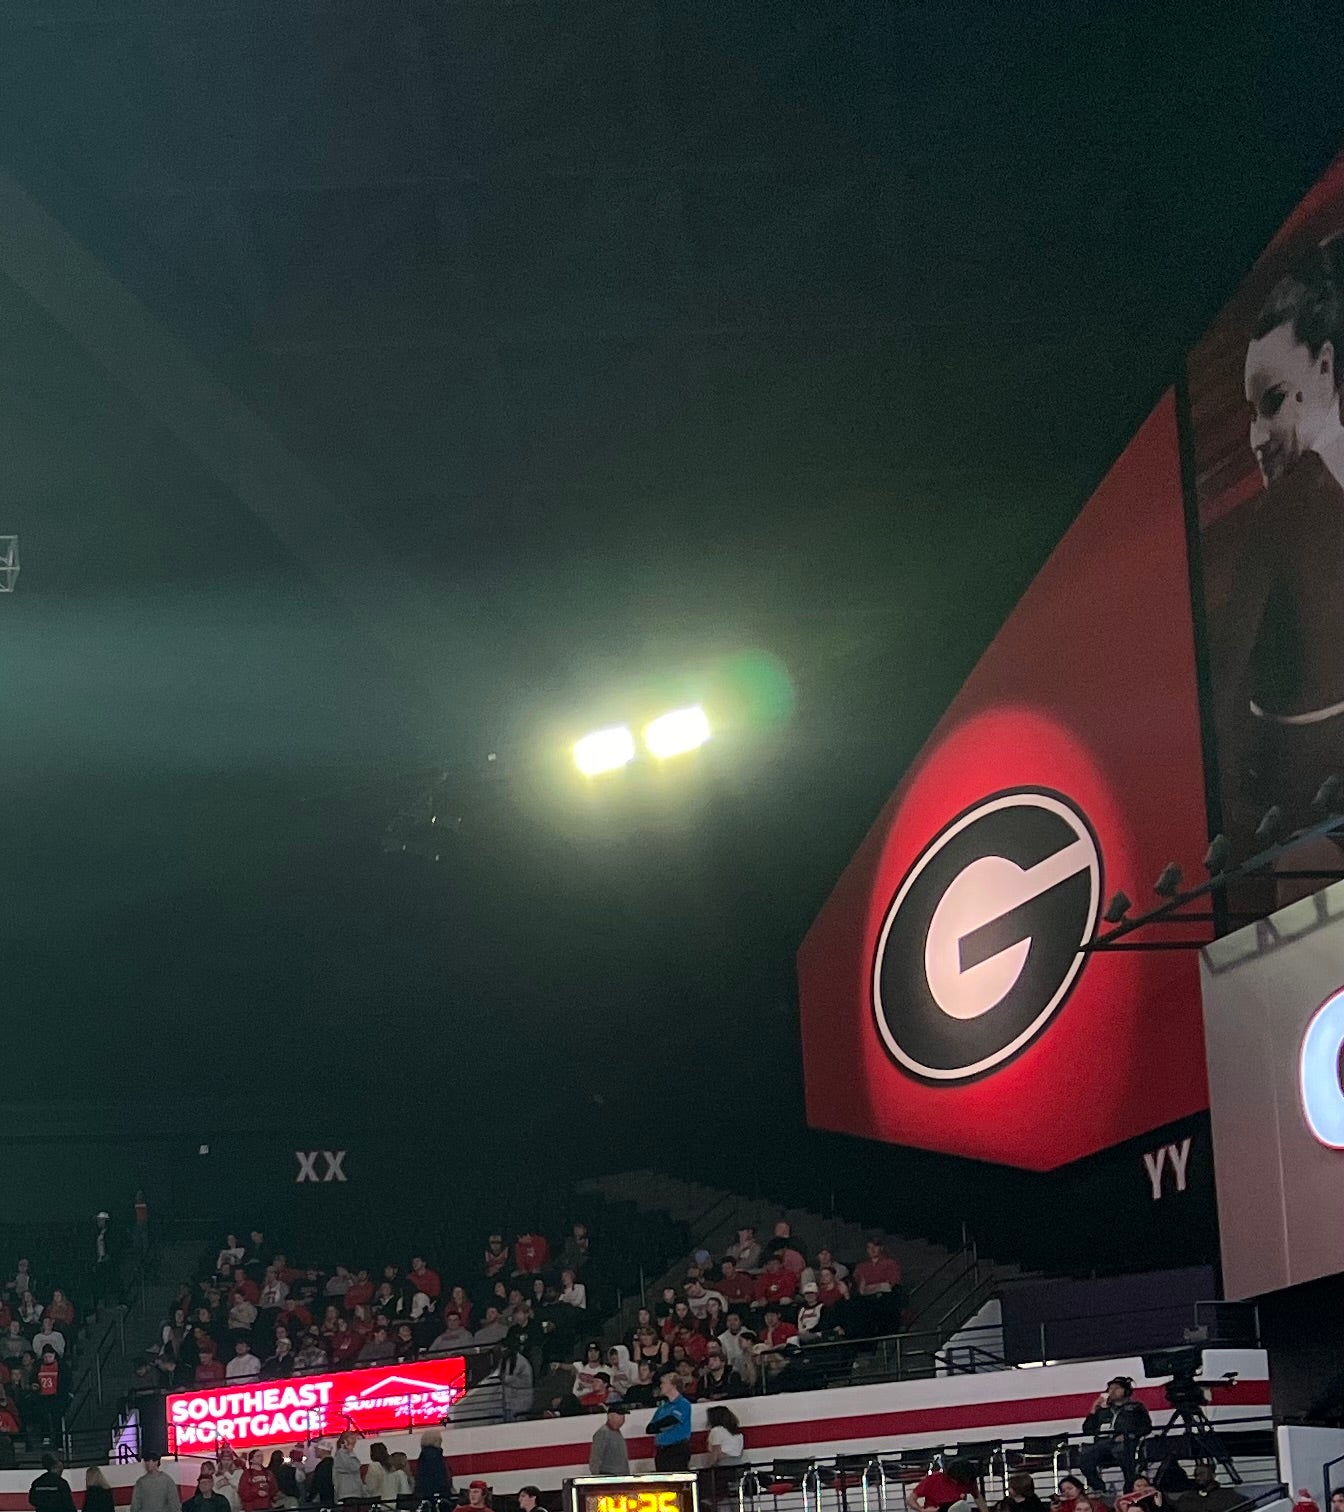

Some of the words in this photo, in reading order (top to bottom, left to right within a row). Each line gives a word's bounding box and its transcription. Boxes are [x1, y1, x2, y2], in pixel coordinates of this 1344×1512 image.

[296, 1151, 348, 1182] XX
[1144, 1137, 1192, 1199] YY
[172, 1380, 334, 1422] SOUTHEAST
[175, 1407, 327, 1446] MORTGAGE
